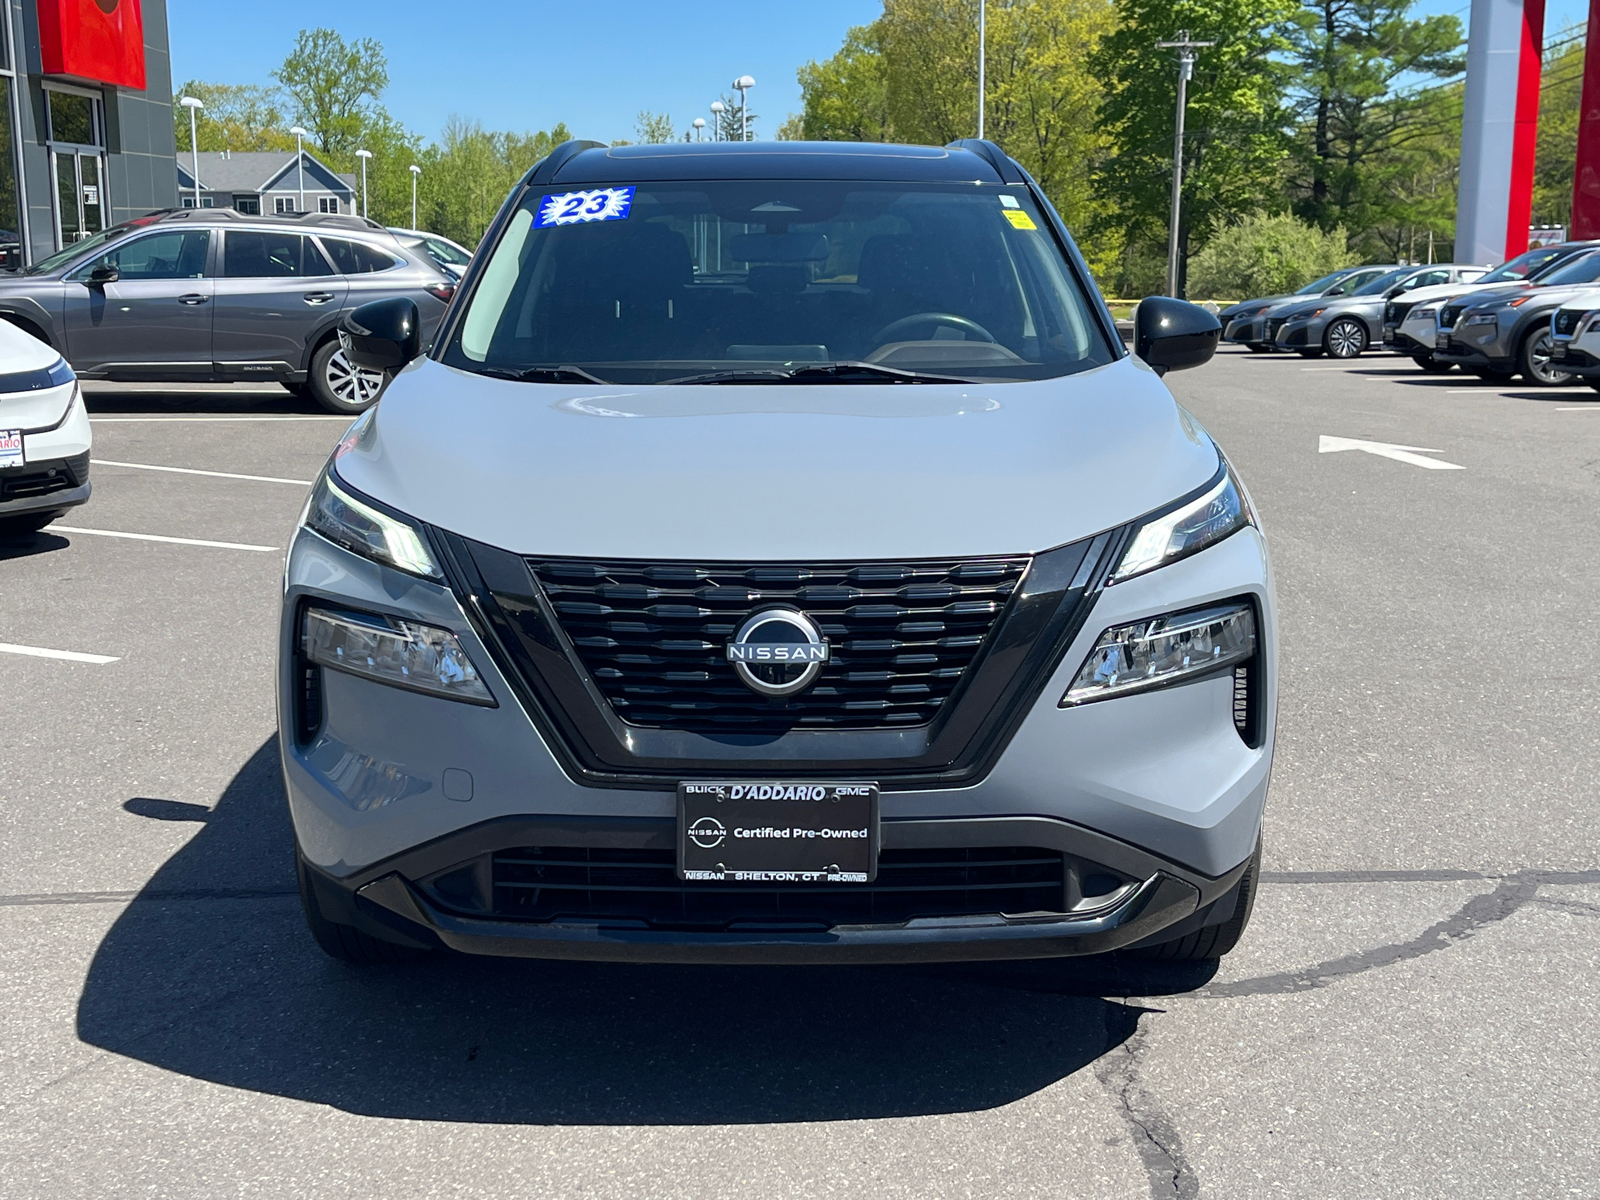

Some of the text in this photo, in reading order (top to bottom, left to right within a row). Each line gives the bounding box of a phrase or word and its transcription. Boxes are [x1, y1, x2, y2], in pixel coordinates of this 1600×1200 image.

[558, 194, 609, 218] 23
[729, 646, 825, 660] NISSAN
[686, 785, 870, 801] BUICK D'ADDARIO GMC
[733, 827, 868, 838] Certified Pre-Owned
[685, 872, 868, 883] NISSAN SHELTON, CT PRE-OWNED
